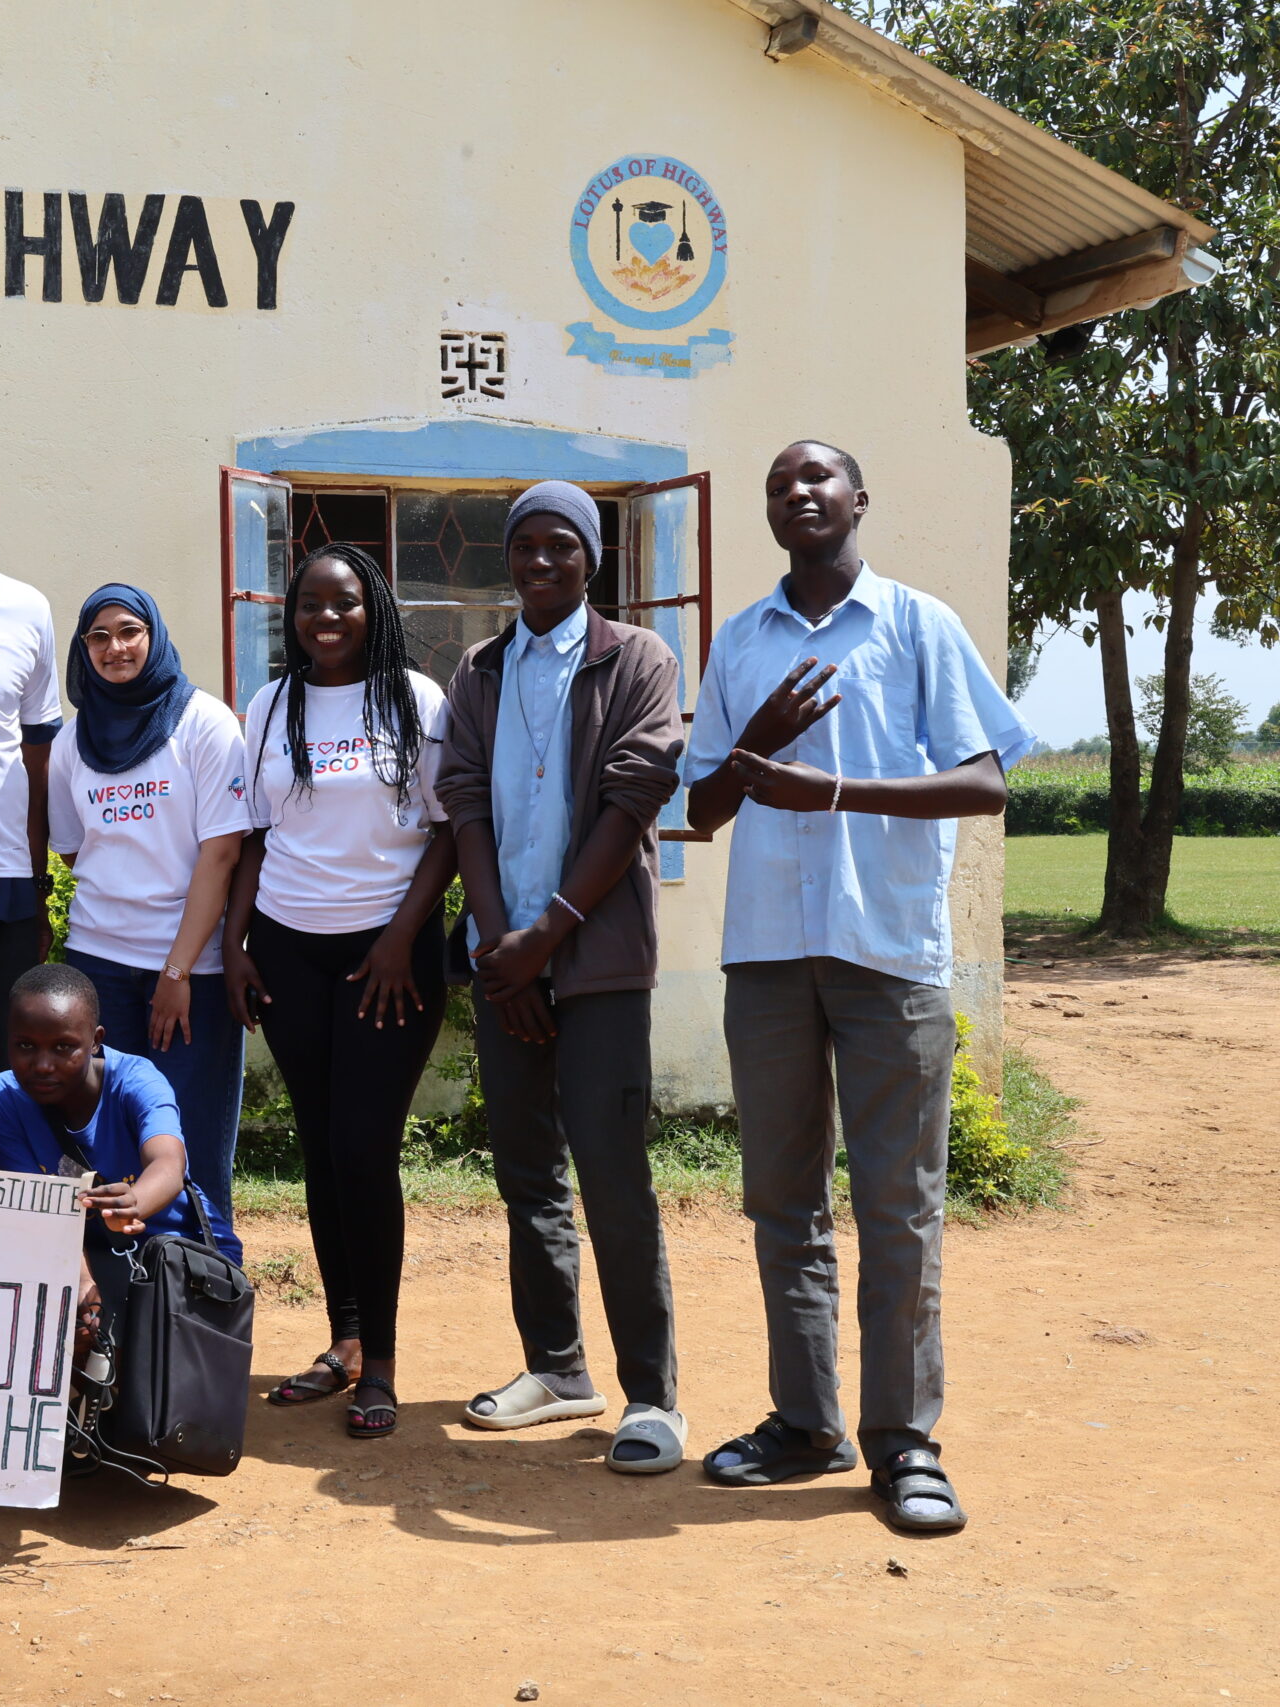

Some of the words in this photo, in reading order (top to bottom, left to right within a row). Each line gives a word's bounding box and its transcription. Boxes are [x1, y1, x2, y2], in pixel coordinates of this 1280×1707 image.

[574, 166, 625, 231] LOTUS
[628, 159, 657, 177] OF
[661, 162, 728, 256] HIGHWAY
[87, 786, 116, 804] WE
[134, 780, 170, 799] ARE
[102, 802, 155, 824] CISCO
